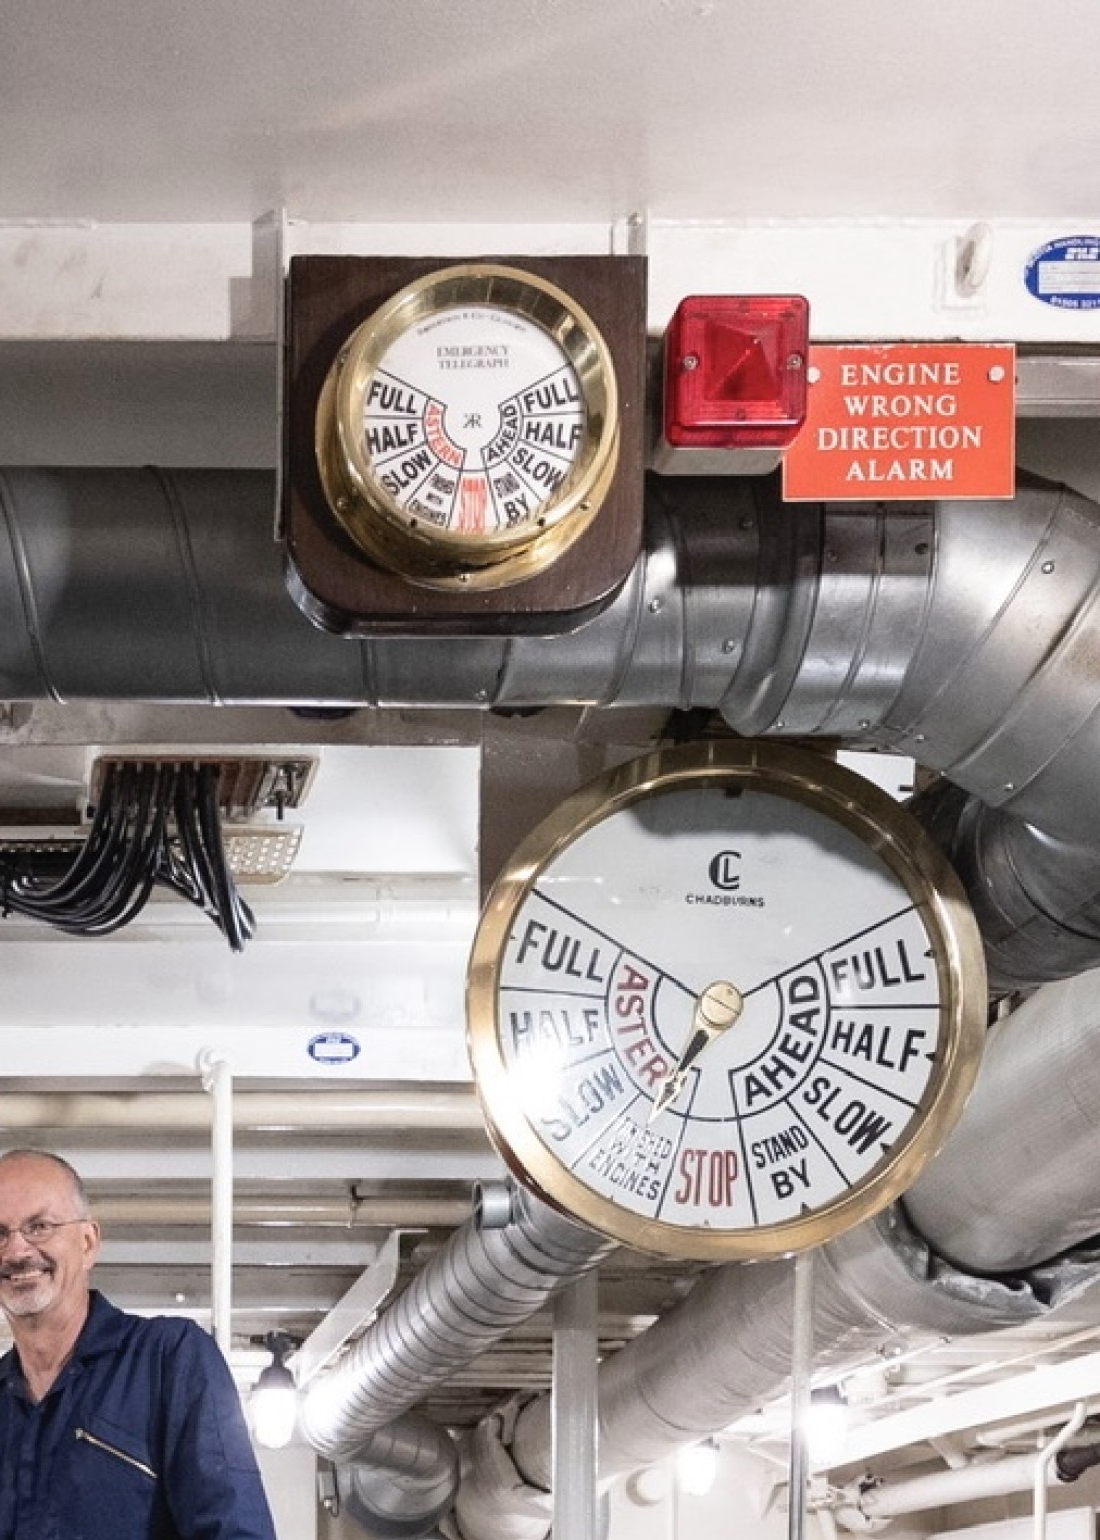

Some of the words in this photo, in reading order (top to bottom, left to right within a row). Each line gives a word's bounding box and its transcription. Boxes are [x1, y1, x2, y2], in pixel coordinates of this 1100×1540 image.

[436, 345, 509, 358] EMERGENCY
[437, 357, 510, 370] TELEGRAPH
[523, 377, 580, 413] FULL
[840, 363, 962, 386] ENGINE
[366, 380, 417, 414] FULL
[843, 395, 957, 417] WRONG
[365, 423, 418, 455] HALF
[488, 404, 518, 462] AHEAD
[525, 421, 583, 451] HALF
[817, 425, 984, 450] DIRECTION
[381, 449, 433, 496] SLOW
[512, 447, 567, 492] SLOW
[845, 458, 955, 482] ALARM
[504, 493, 530, 528] BY
[684, 894, 765, 907] CHADBURNS
[515, 919, 603, 983] FULL
[830, 938, 926, 993] FULL
[614, 964, 680, 1098] ASTER
[744, 975, 820, 1107] AHEAD
[831, 1020, 926, 1073] HALF
[541, 1062, 625, 1142] SLOW
[803, 1077, 893, 1155] SLOW
[751, 1125, 810, 1169] STAND
[589, 1149, 662, 1201] ENGINES
[674, 1148, 739, 1207] STOP
[770, 1156, 811, 1200] BY
